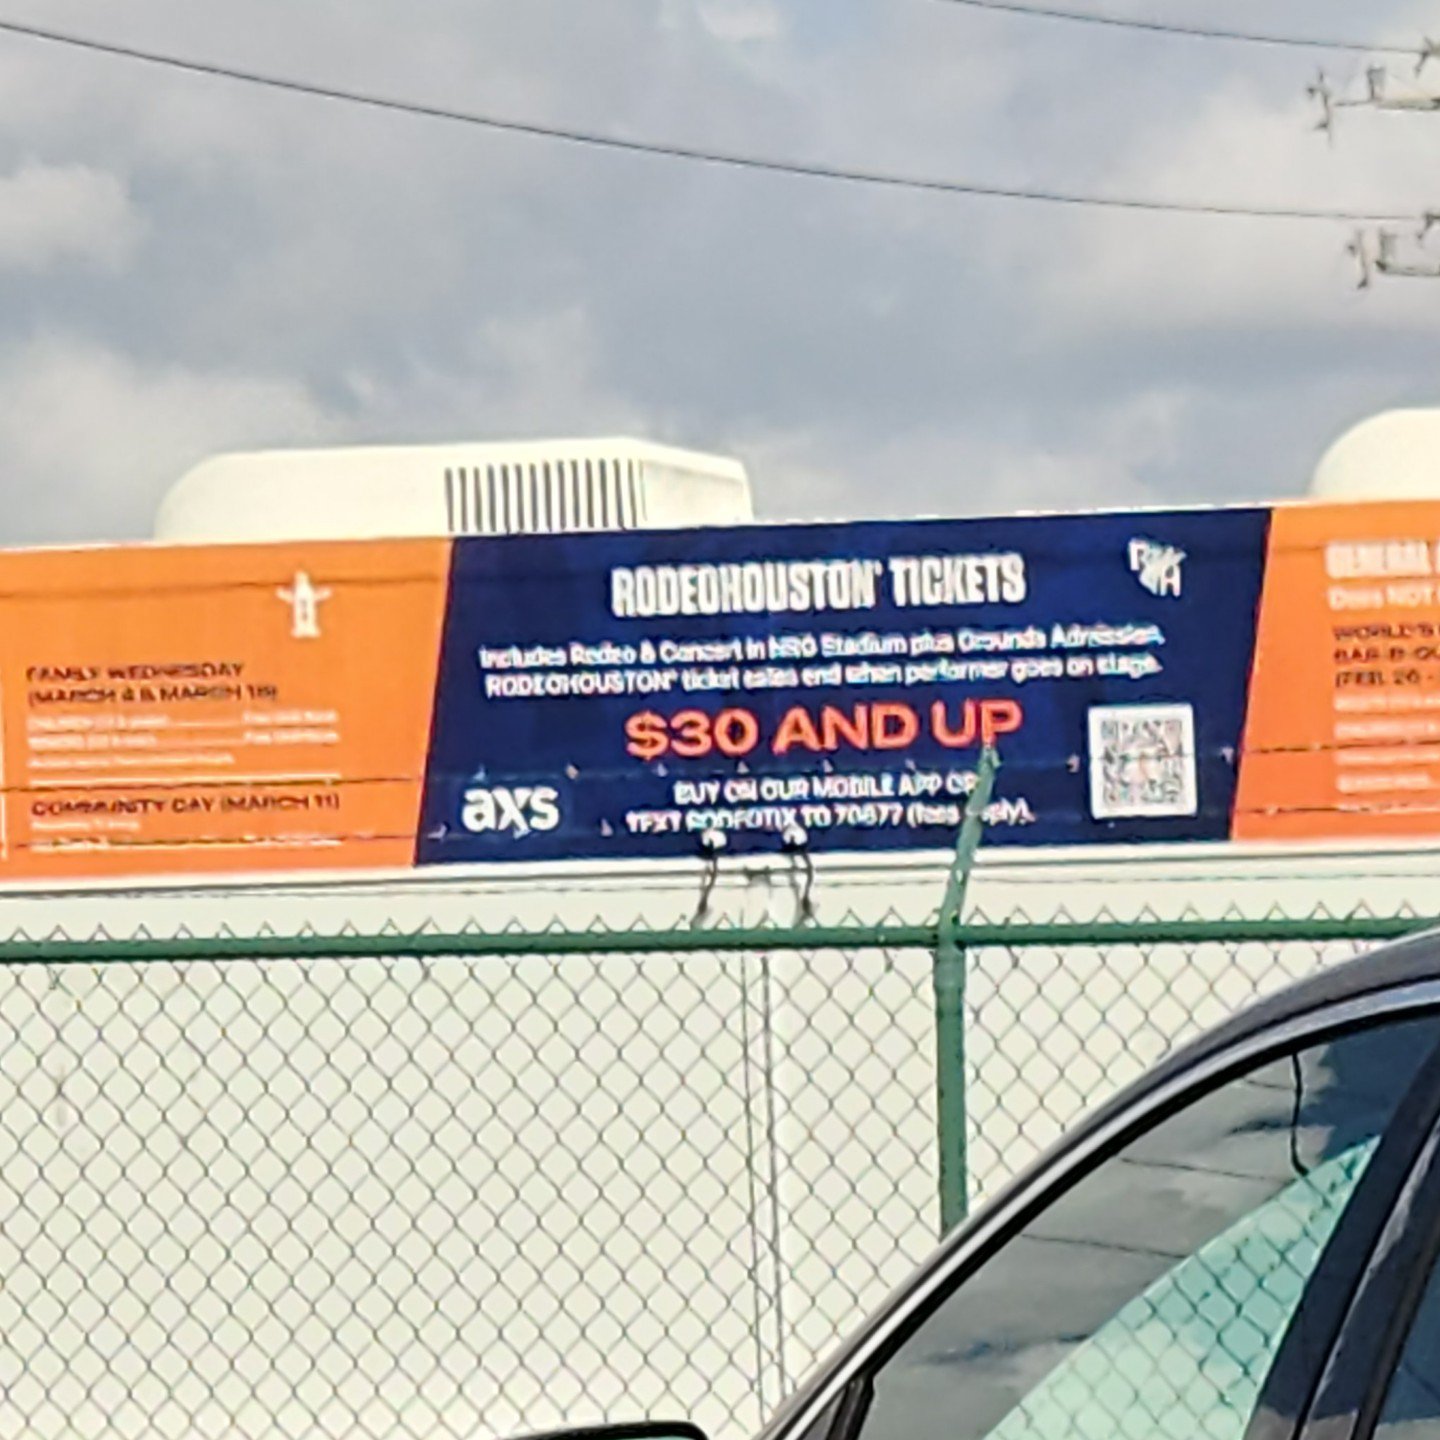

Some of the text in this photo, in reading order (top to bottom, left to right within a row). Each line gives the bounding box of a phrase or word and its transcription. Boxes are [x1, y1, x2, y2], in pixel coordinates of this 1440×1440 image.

[888, 552, 1027, 606] TICKETS
[625, 697, 1023, 761] $30 AND UP
[461, 785, 560, 834] axs
[673, 780, 720, 806] BUY
[800, 804, 833, 828] TO
